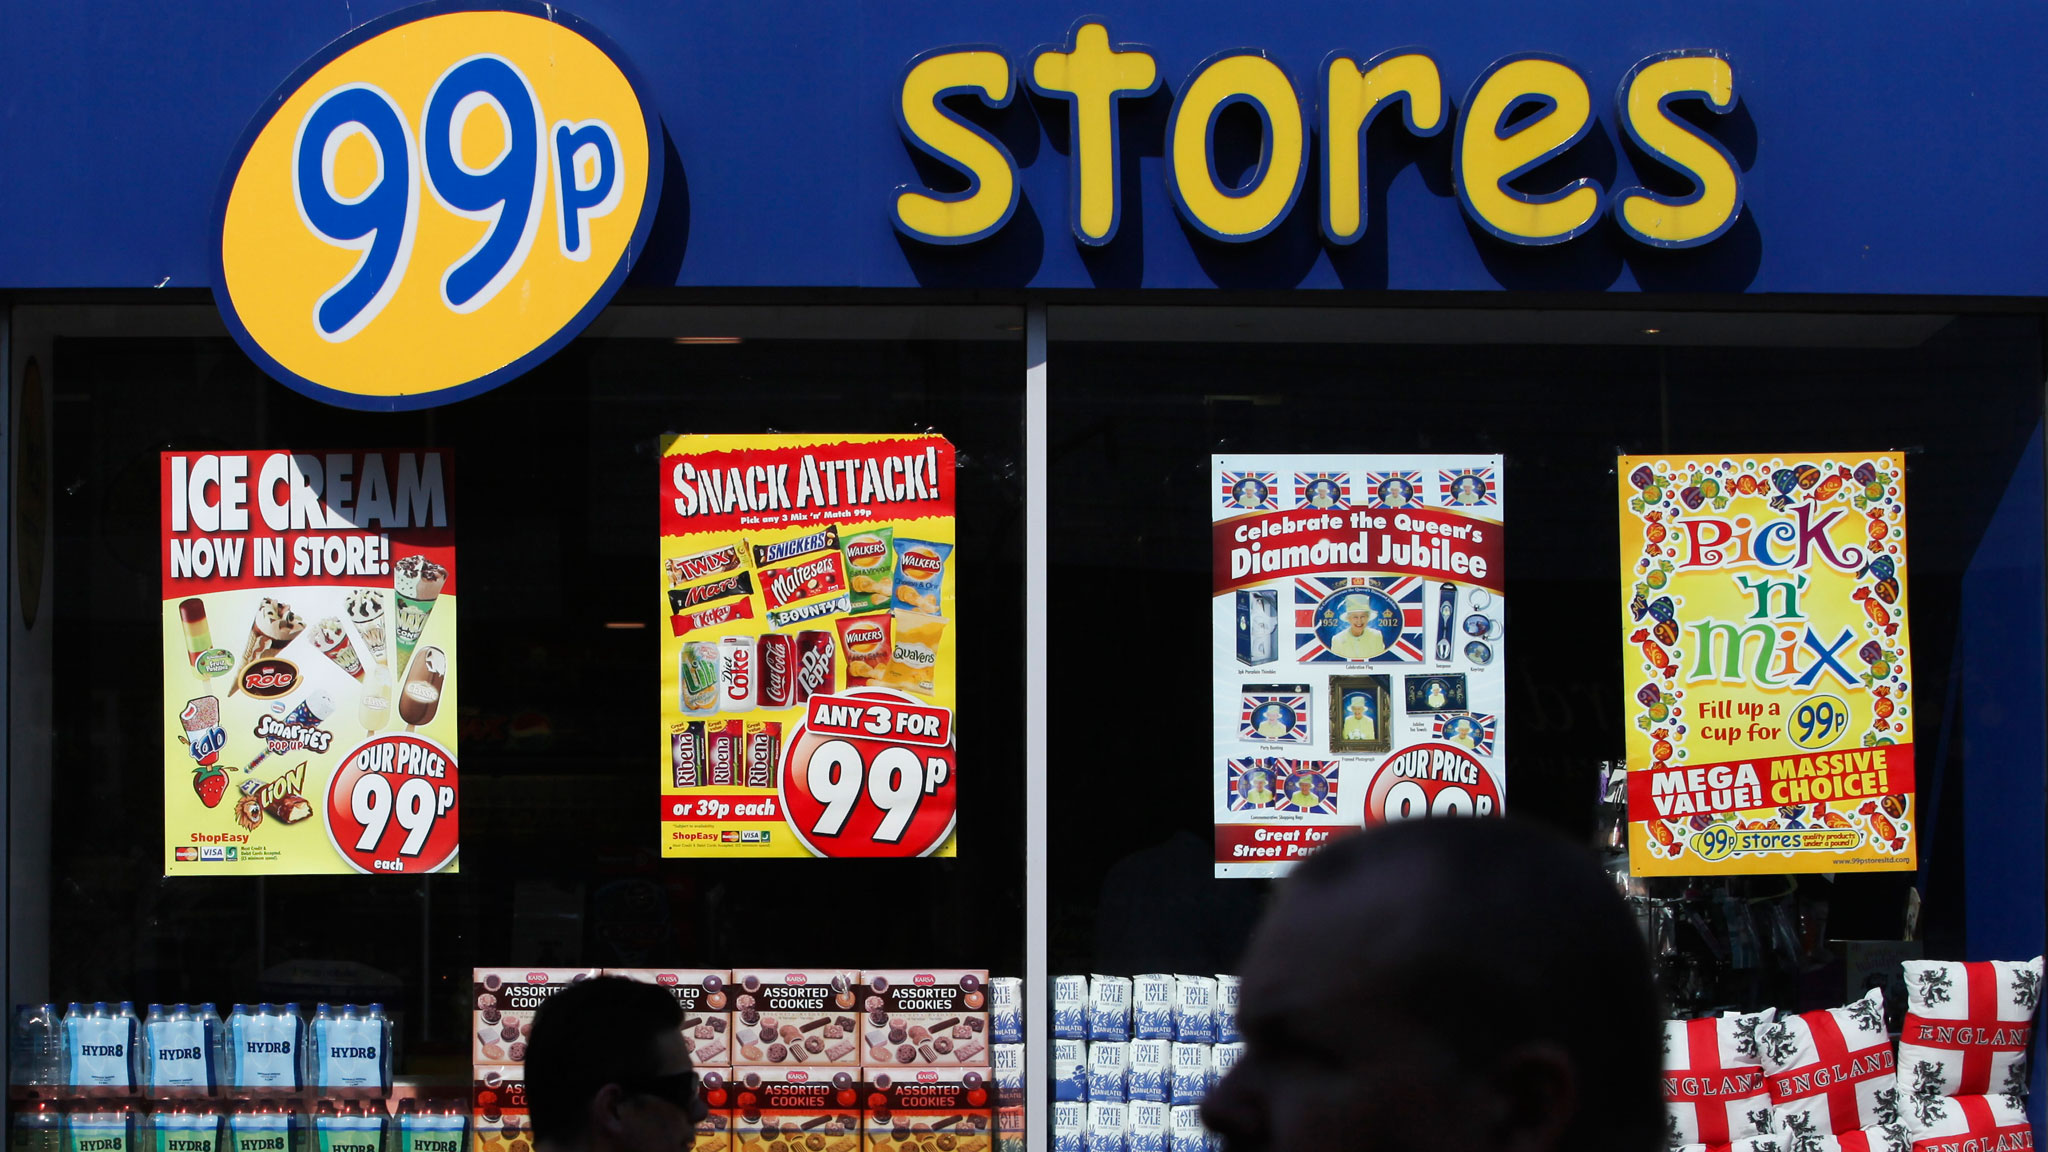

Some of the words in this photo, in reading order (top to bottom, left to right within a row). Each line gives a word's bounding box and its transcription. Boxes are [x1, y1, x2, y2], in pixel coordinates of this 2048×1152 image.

[292, 52, 624, 343] 99p
[893, 14, 1743, 248] stores
[673, 462, 792, 517] SNACK
[796, 446, 940, 508] ATTACK!
[171, 453, 249, 532] ICE
[258, 452, 448, 531] CREAM
[740, 516, 760, 525] Pick
[762, 516, 779, 524] any
[782, 514, 788, 522] 3
[790, 513, 807, 521] Mix
[824, 510, 851, 519] Match
[854, 509, 872, 518] 99p
[1234, 513, 1343, 543] Celebrate
[1350, 511, 1387, 529] the
[1394, 513, 1483, 543] Queen's
[768, 533, 826, 561] SNICKERS
[847, 543, 885, 558] WALKERS
[170, 537, 245, 578] NOW
[253, 537, 284, 577] IN
[293, 533, 390, 577] STORE!
[901, 555, 941, 570] WALKERS
[1231, 531, 1368, 580] Diamond
[1377, 534, 1487, 579] Jubilee
[676, 551, 731, 580] TWIX
[772, 557, 834, 606] Maltesers
[685, 577, 739, 608] Mars
[780, 600, 836, 623] BOUNTY
[1320, 618, 1338, 627] 1952
[1378, 618, 1398, 627] 2012
[846, 630, 882, 644] WALKERS
[802, 645, 823, 671] Dr
[728, 649, 749, 700] Coke
[814, 704, 864, 728] ANY
[864, 705, 892, 735] 3
[896, 712, 940, 738] FOR
[1699, 700, 1732, 719] Fill
[1738, 702, 1763, 721] up
[1768, 703, 1780, 715] a
[1797, 701, 1845, 743] 99p
[1700, 726, 1741, 746] cup
[1747, 722, 1781, 741] for
[189, 726, 227, 761] fab
[269, 741, 288, 751] POP
[290, 741, 304, 751] UP
[357, 742, 395, 773] OUR
[396, 743, 446, 778] PRICE
[677, 732, 696, 788] Ribena
[714, 736, 731, 785] Ribena
[748, 733, 769, 788] Ribena
[1393, 749, 1430, 780] OUR
[1431, 748, 1478, 785] PRICE
[1770, 749, 1888, 781] MASSIVE
[1651, 763, 1760, 796] MEGA
[807, 739, 948, 843] 99p
[1770, 770, 1889, 804] CHOICE!
[1651, 784, 1763, 817] VALUE!
[351, 773, 454, 855] 99p
[673, 803, 692, 816] or
[696, 799, 730, 819] 39p
[734, 798, 775, 816] each
[191, 832, 249, 844] ShopEasy
[673, 832, 718, 841] ShopEasy
[1254, 828, 1300, 841] Great
[1305, 828, 1329, 841] for
[1802, 833, 1825, 841] quality
[1826, 832, 1855, 840] products
[1703, 829, 1735, 856] 99p
[1742, 832, 1801, 849] stores
[203, 848, 222, 856] VISA
[1233, 844, 1282, 857] Street
[374, 858, 403, 871] each
[505, 986, 568, 996] ASSORTE
[763, 987, 829, 998] ASSORTED
[892, 988, 957, 999] ASSORTED
[1099, 983, 1123, 993] TATE
[1143, 983, 1167, 992] TATE
[1184, 986, 1208, 995] TATE
[511, 997, 546, 1008] COOK
[1100, 993, 1122, 1002] LYLE
[1145, 992, 1167, 1001] LYLE
[1186, 995, 1208, 1005] LYLE
[770, 999, 824, 1009] COOKIES
[898, 999, 952, 1010] COOKIES
[82, 1044, 123, 1058] HYDR8
[159, 1046, 201, 1060] HYDR8
[247, 1041, 290, 1054] HYDR8
[331, 1047, 376, 1059] HYDR8
[1096, 1046, 1120, 1055] TATE
[1135, 1044, 1159, 1053] TATE
[1097, 1056, 1120, 1065] LYLE
[1136, 1054, 1159, 1063] LYLE
[1779, 1050, 1894, 1097] ENGLAND
[765, 1085, 830, 1096] ASSORTED
[895, 1085, 960, 1096] ASSORTED
[1662, 1073, 1764, 1097] NGLAND
[771, 1096, 825, 1107] COOKIES
[902, 1096, 955, 1107] COOKIES
[1136, 1106, 1161, 1115] TATE
[1138, 1116, 1161, 1125] LYLE
[80, 1137, 122, 1151] HYDR8
[169, 1140, 211, 1152] HYDR8
[241, 1137, 284, 1150] HYDR8
[415, 1140, 457, 1152] HYDR8
